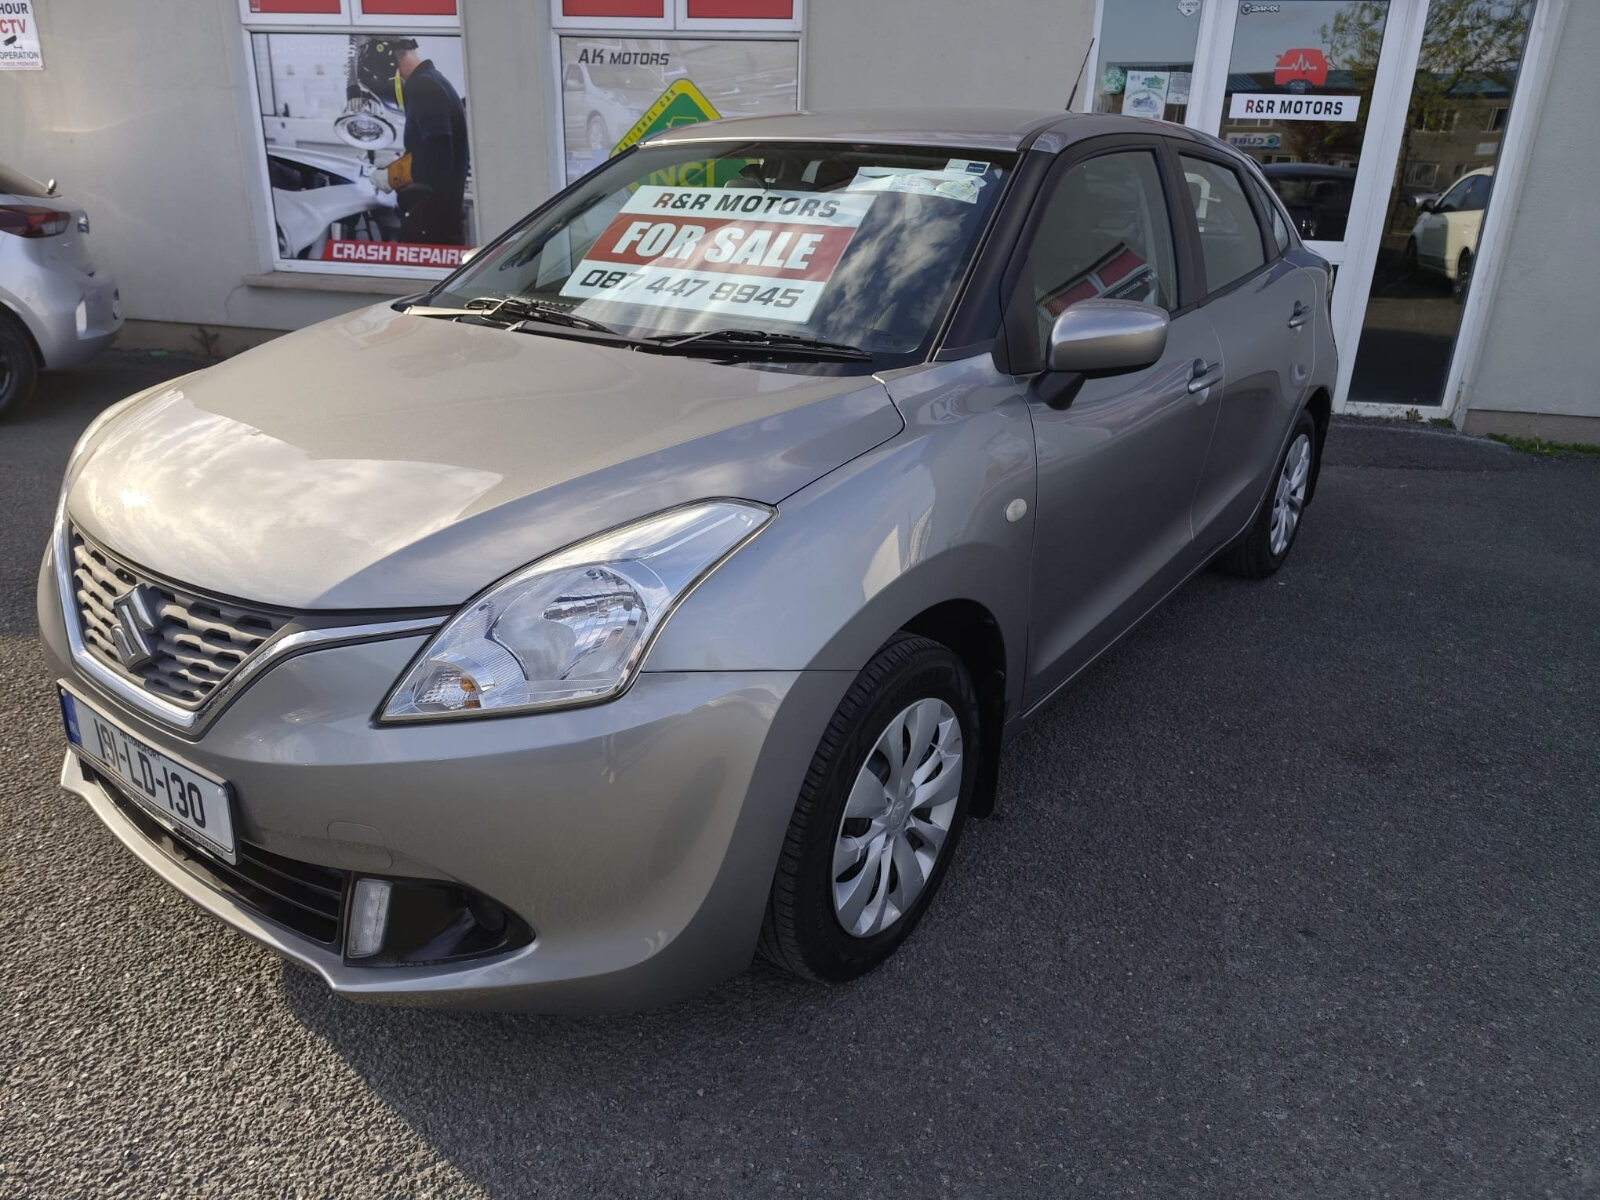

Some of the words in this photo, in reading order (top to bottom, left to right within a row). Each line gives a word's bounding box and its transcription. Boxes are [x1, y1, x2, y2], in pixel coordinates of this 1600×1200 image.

[578, 48, 604, 64] AK
[609, 52, 670, 65] MOTORS
[1245, 99, 1275, 114] R&R
[1279, 100, 1343, 115] MOTORS
[653, 192, 711, 211] R&R
[713, 193, 841, 218] MOTORS
[332, 243, 391, 261] CRASH
[611, 220, 706, 260] FOR
[704, 226, 824, 271] SALE
[579, 269, 646, 290] 087
[645, 275, 710, 298] 447
[93, 717, 206, 829] 191-LD-130
